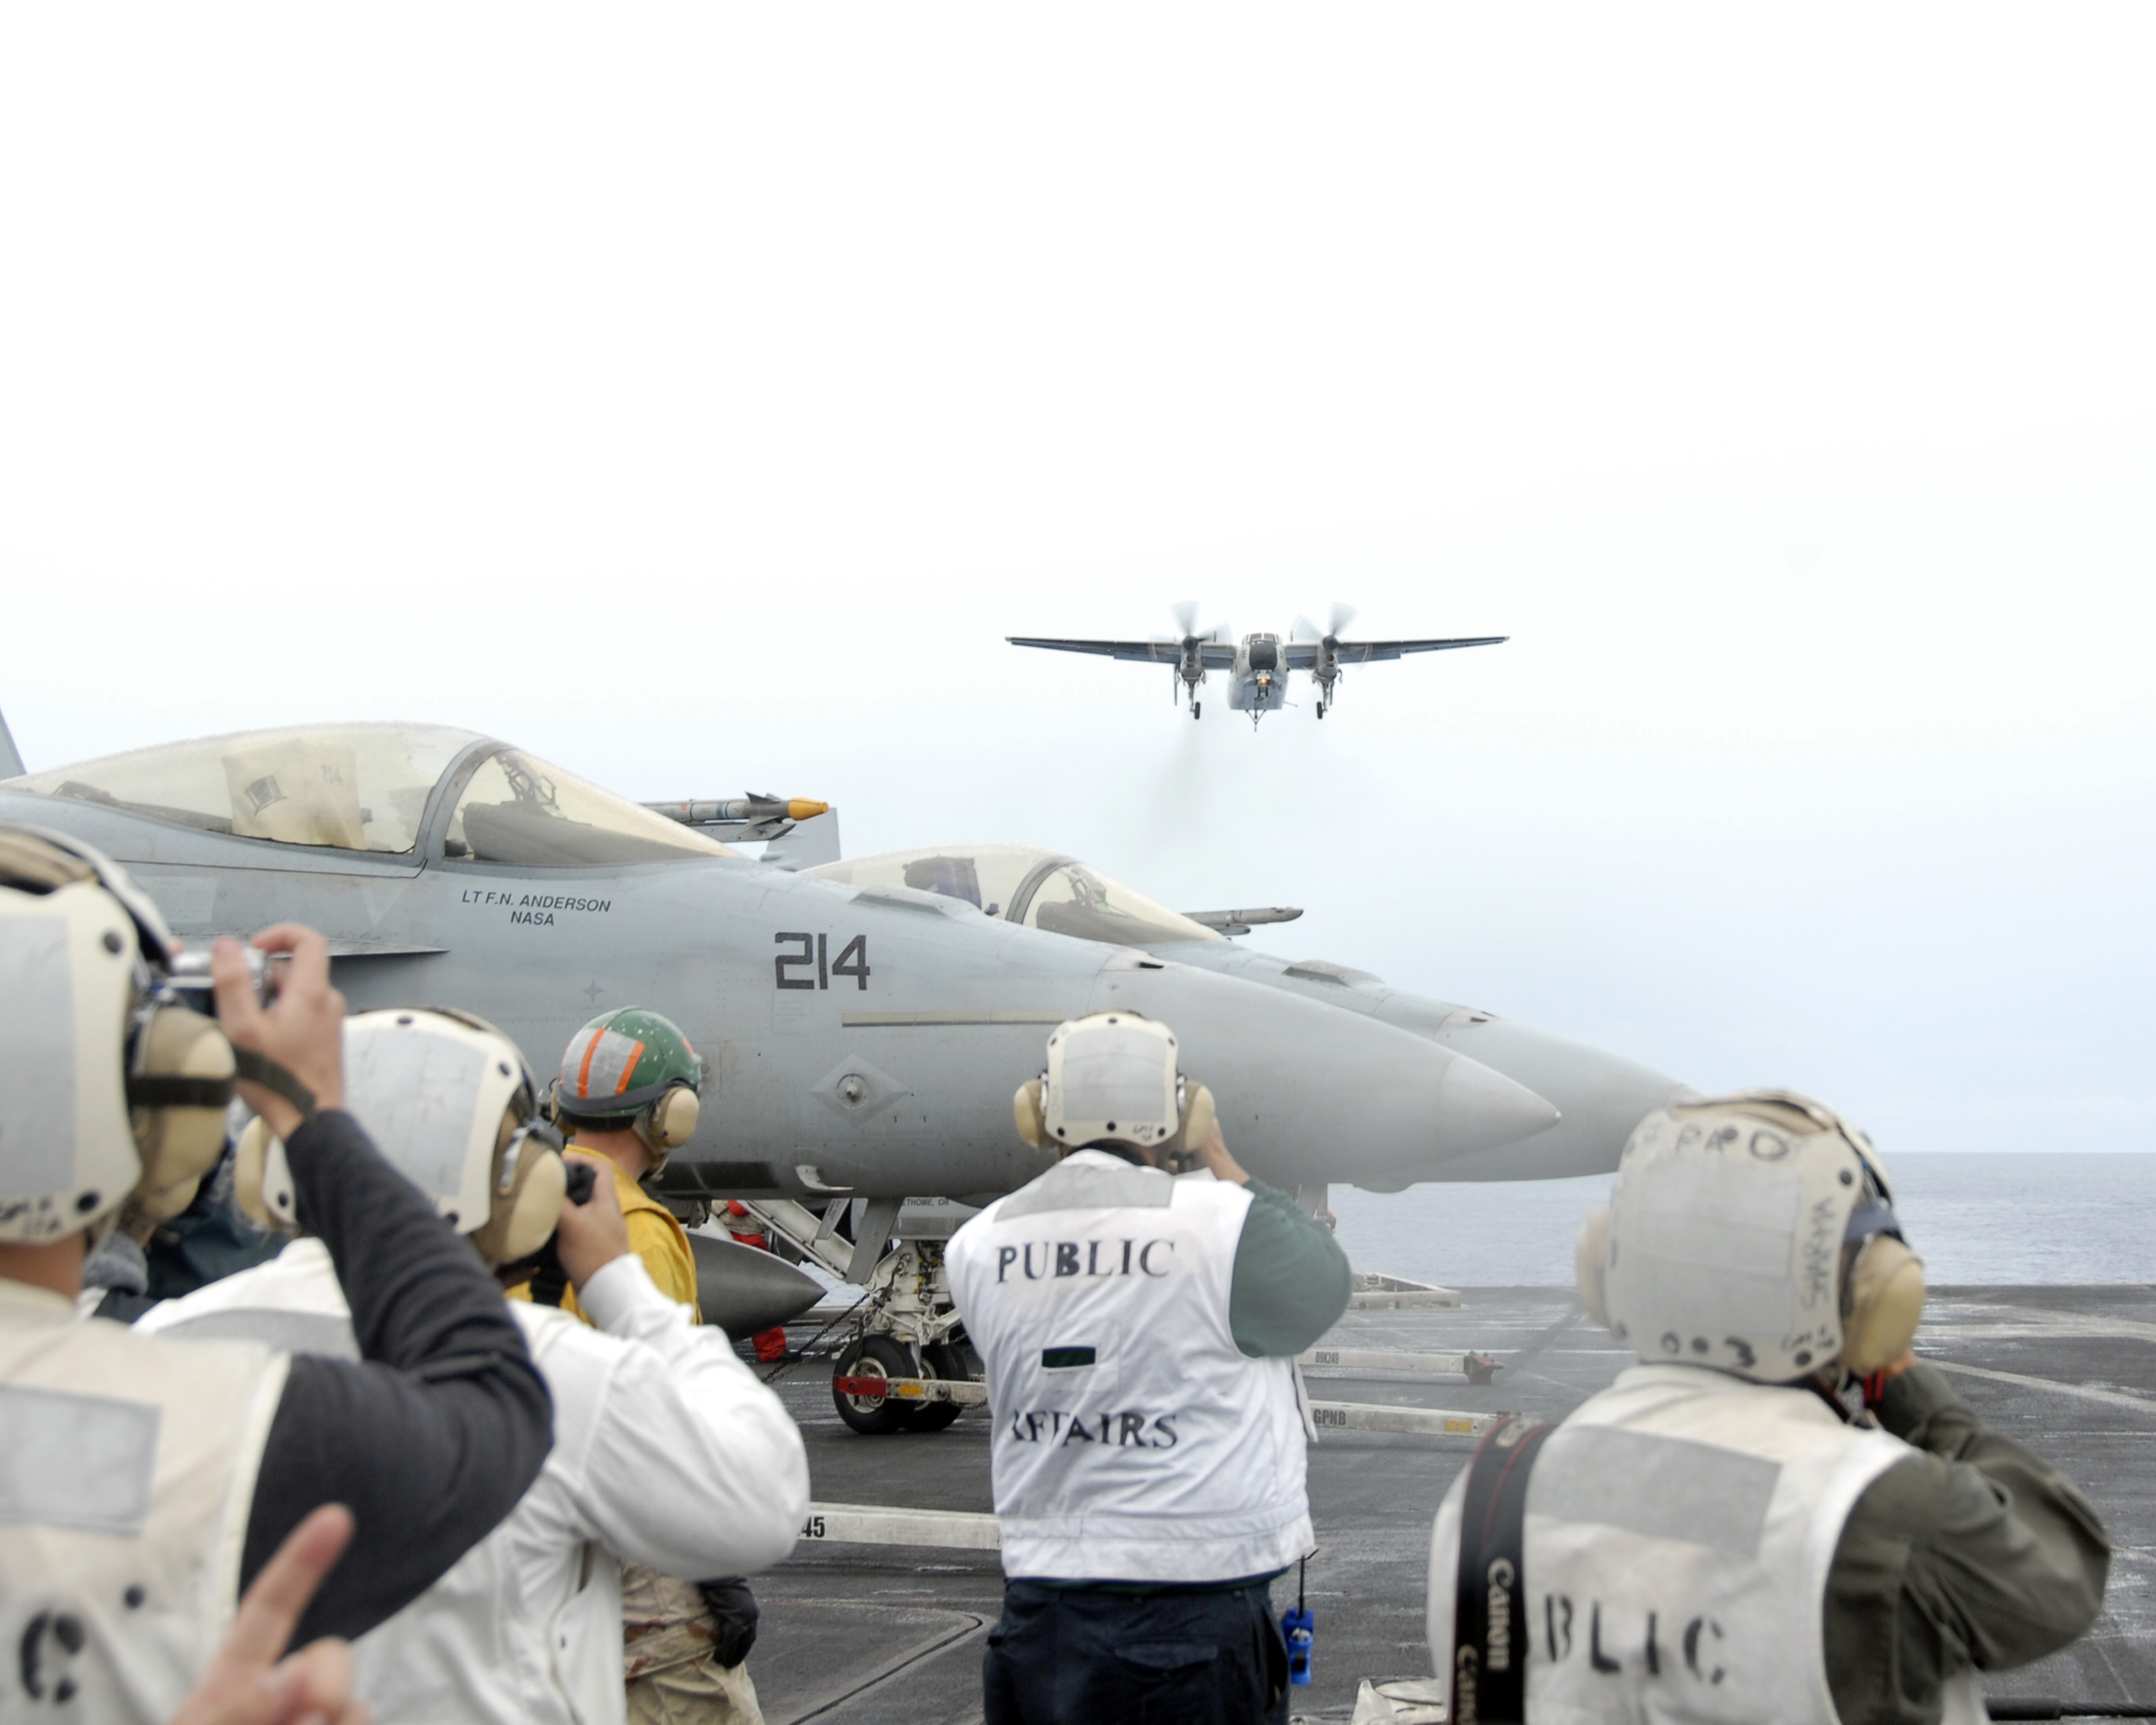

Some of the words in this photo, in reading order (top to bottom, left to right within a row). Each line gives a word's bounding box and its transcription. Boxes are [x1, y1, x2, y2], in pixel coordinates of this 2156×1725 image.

[461, 890, 482, 903] LT
[485, 891, 515, 906] F.N.
[519, 894, 612, 912] ANDERSON
[510, 911, 554, 926] NASA
[775, 932, 871, 990] 214
[995, 1238, 1176, 1284] PUBLIC
[1314, 1409, 1346, 1425] GPNB
[1487, 1556, 1515, 1670] Canon
[1544, 1593, 1726, 1685] BLIC
